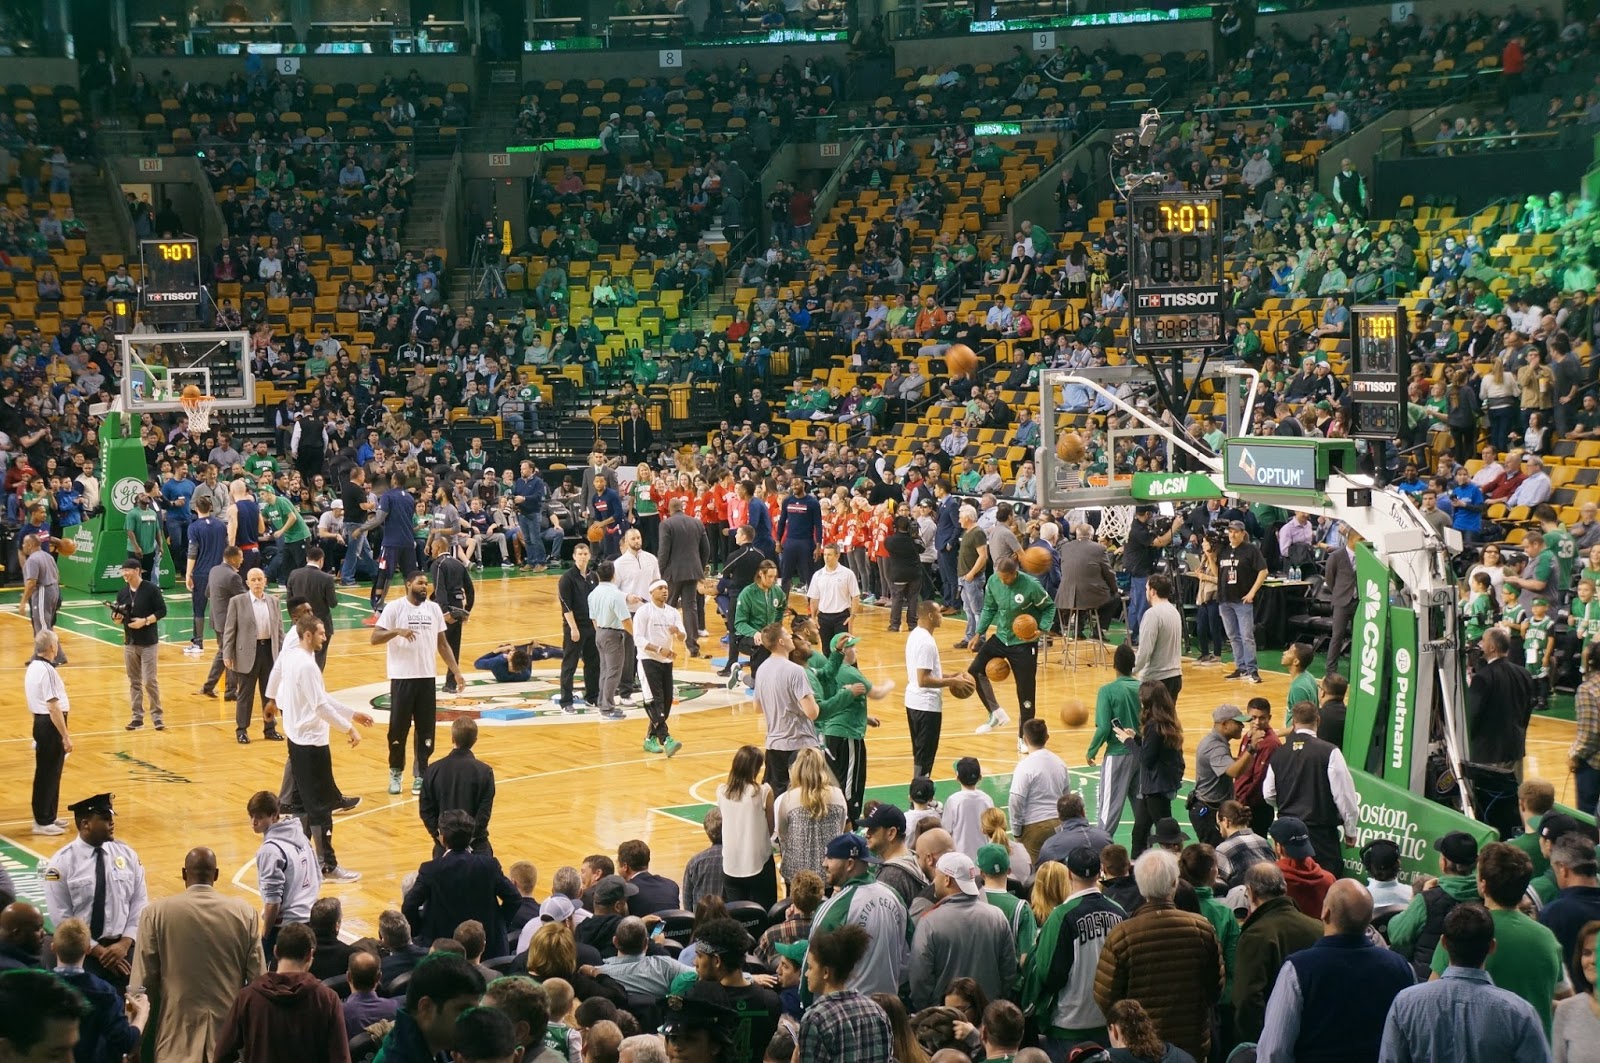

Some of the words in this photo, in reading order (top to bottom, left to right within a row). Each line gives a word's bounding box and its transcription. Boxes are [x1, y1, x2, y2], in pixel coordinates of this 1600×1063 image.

[1039, 34, 1047, 47] 9
[666, 52, 674, 64] 8
[284, 60, 292, 72] 8
[823, 145, 839, 155] EXIT
[143, 159, 160, 170] EXIT
[492, 155, 508, 165] EXIT
[1160, 206, 1209, 232] 7:07
[159, 244, 191, 260] 7:07
[161, 292, 198, 300] TISSOT
[1160, 292, 1218, 306] TISSOT
[1365, 381, 1397, 392] TISSOT
[1256, 467, 1301, 485] OPTUM
[1163, 476, 1189, 494] CSN
[1360, 621, 1380, 696] CSN
[1392, 677, 1409, 769] Putnam
[859, 899, 876, 928] OSTON
[664, 928, 692, 937] utnam
